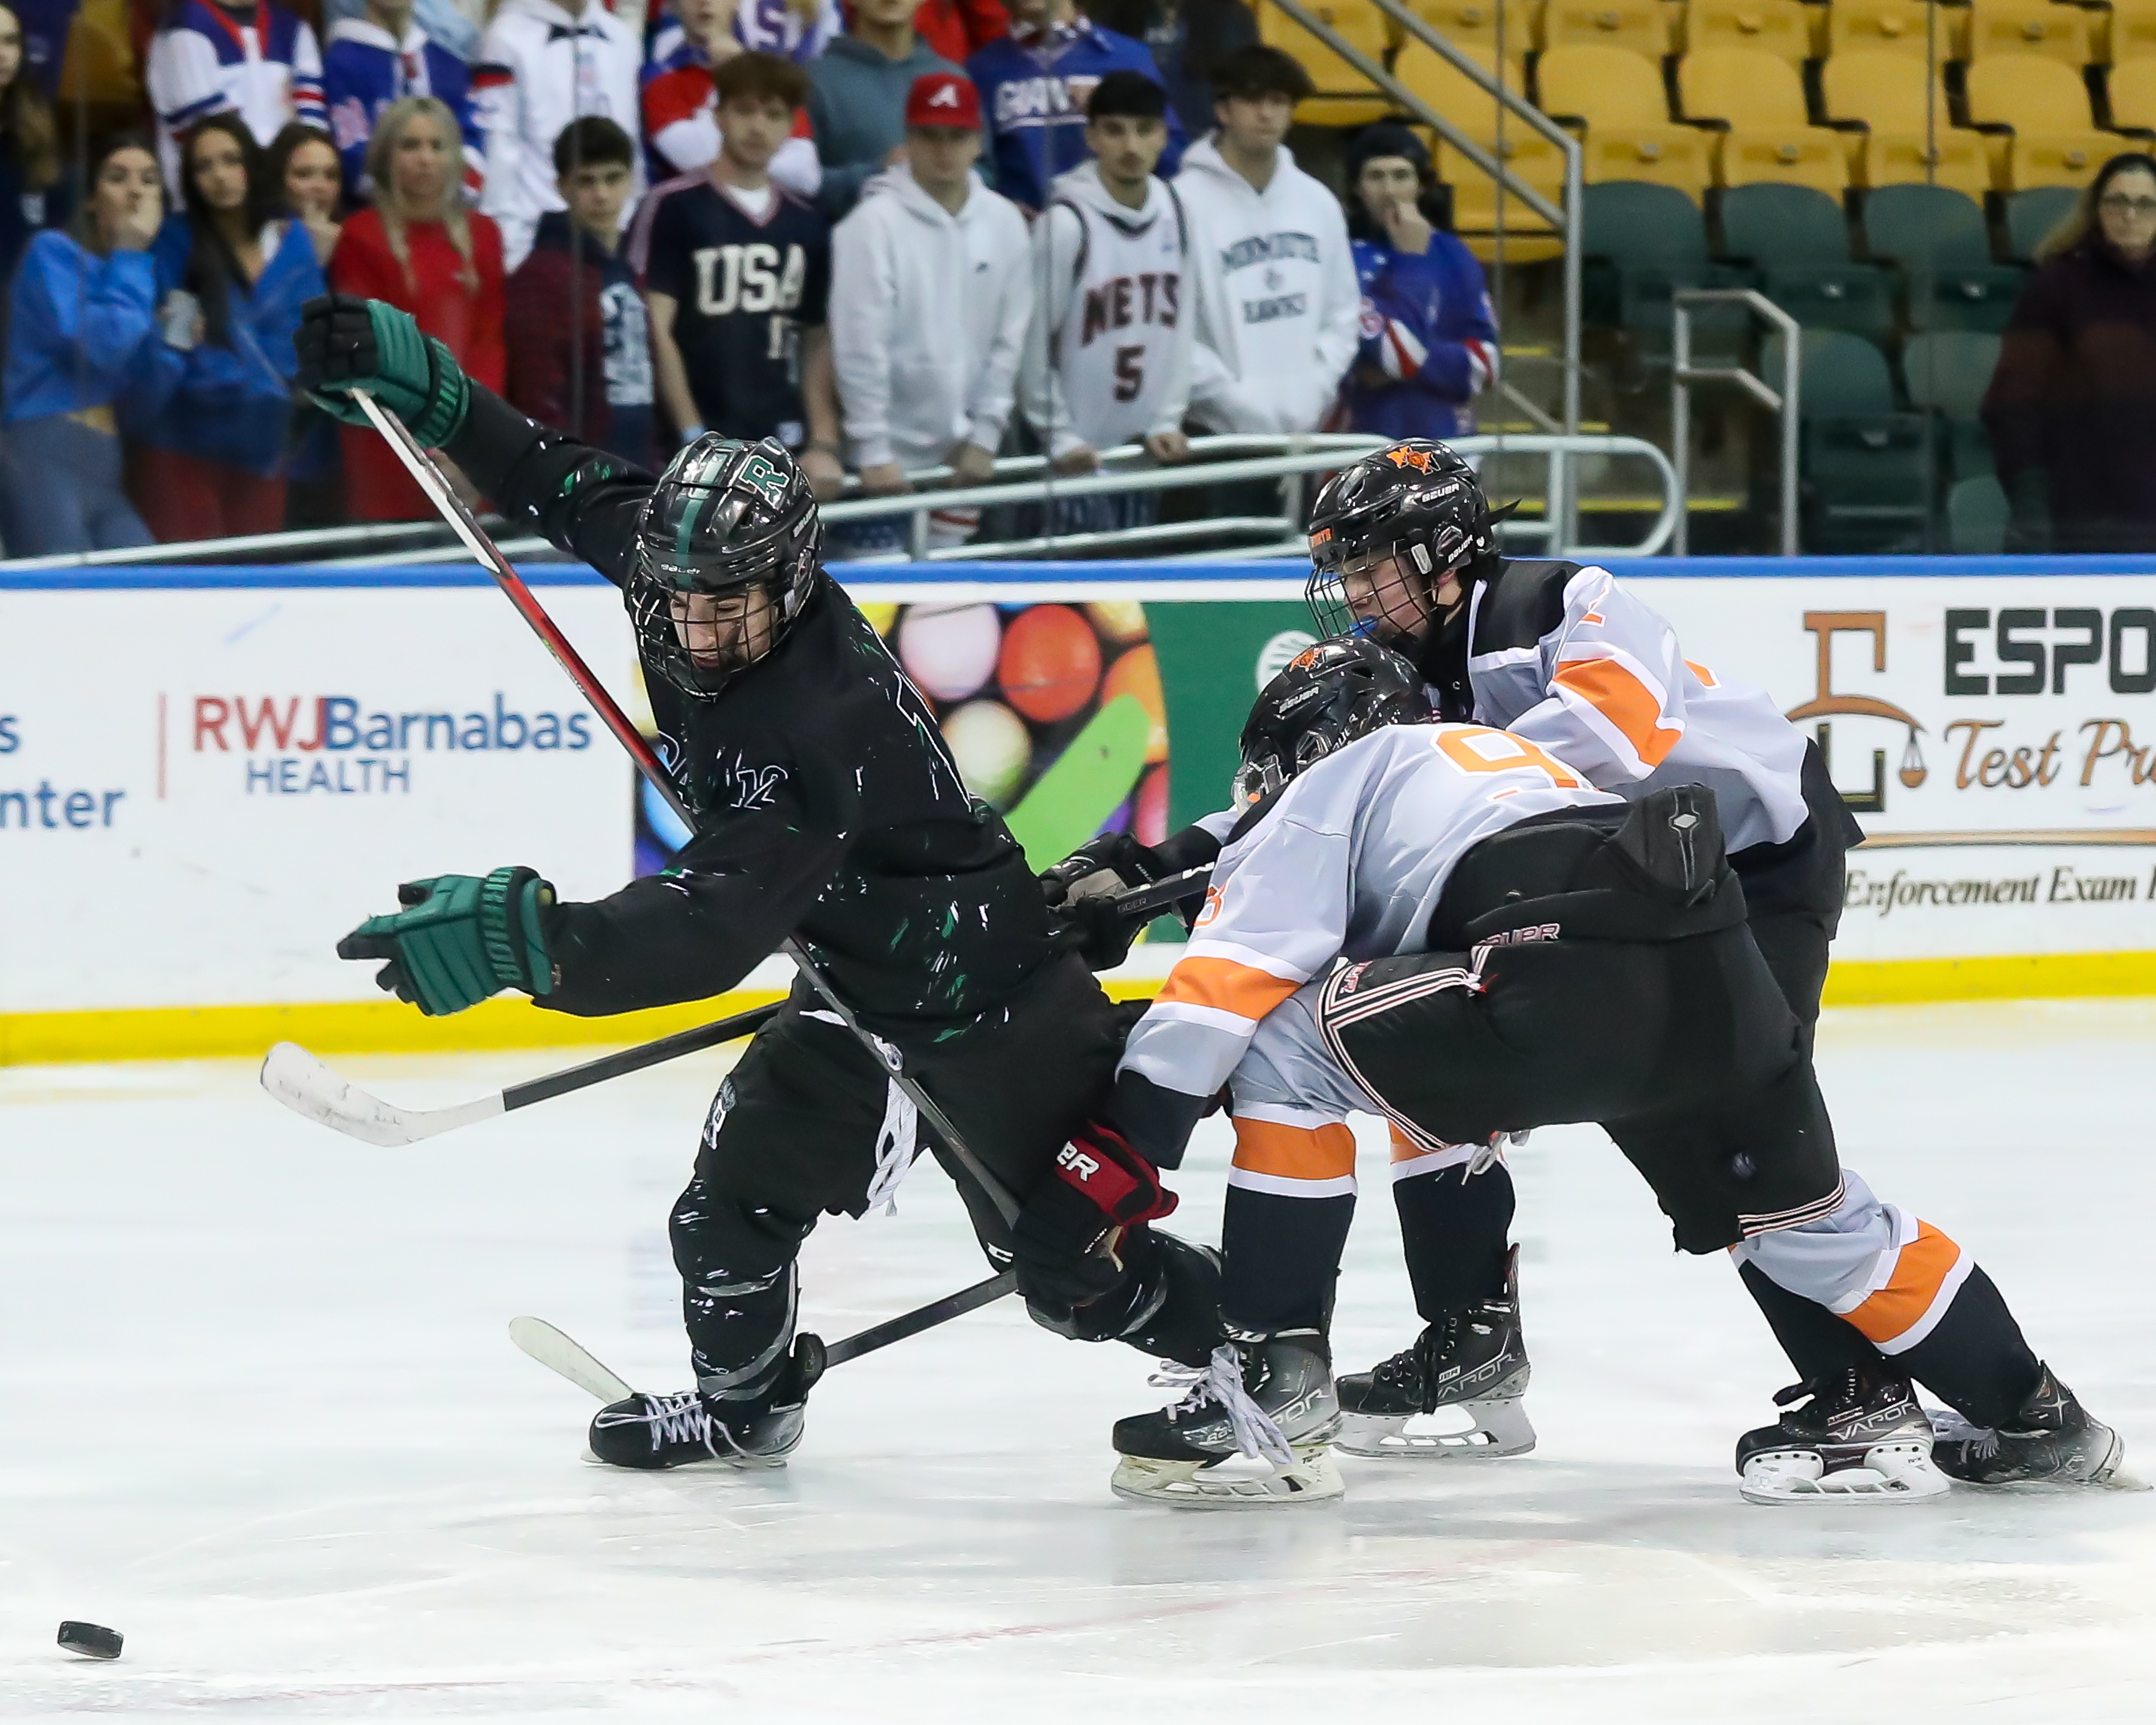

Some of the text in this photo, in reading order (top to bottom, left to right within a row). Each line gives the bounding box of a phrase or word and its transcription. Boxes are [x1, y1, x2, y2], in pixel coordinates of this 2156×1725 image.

[928, 84, 958, 108] A
[694, 243, 806, 314] USA
[1081, 273, 1179, 346] NETS
[1114, 343, 1145, 402] 5
[739, 455, 790, 511] R
[1422, 482, 1459, 503] BAUER
[193, 692, 591, 751] RWJBarnabas
[246, 759, 410, 794] HEALTH
[1944, 718, 2156, 789] Test Pr
[0, 780, 125, 830] nter
[2048, 865, 2137, 902] Exam
